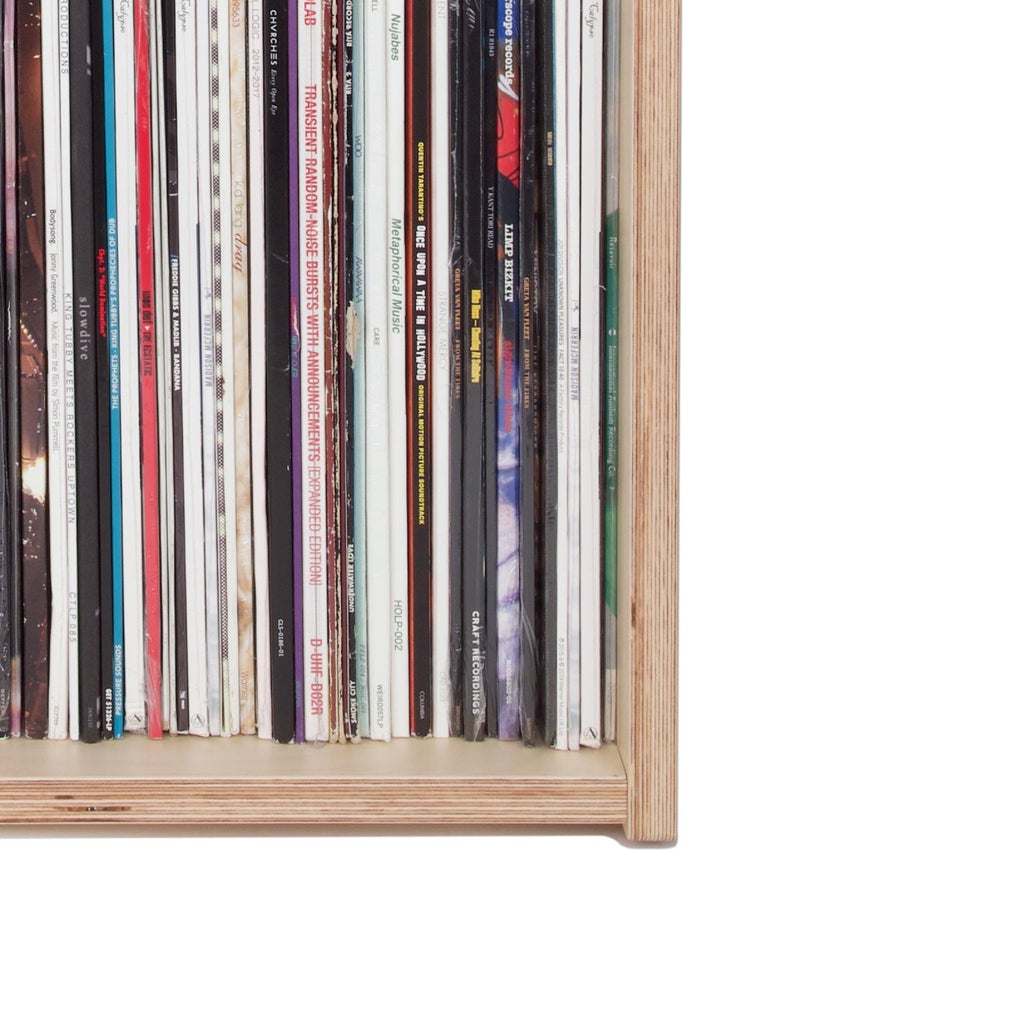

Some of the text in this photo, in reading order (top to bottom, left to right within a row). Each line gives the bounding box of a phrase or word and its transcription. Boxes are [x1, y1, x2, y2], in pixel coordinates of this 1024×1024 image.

[389, 13, 401, 61] Nujabes
[270, 69, 278, 84] Every
[503, 38, 516, 84] records
[269, 88, 277, 103] Open
[270, 104, 278, 116] Eye
[304, 84, 317, 154] TRANSIENT
[108, 218, 116, 234] DUB
[306, 158, 318, 257] RANDOM-NOISE
[109, 236, 116, 247] OF
[415, 225, 426, 248] ONCE
[48, 209, 58, 314] Bodysong. Jonny Greenwood.
[109, 248, 117, 295] PROPHECIES
[171, 258, 180, 287] FREDDIE
[389, 218, 403, 334] Metaphorical Music
[416, 252, 426, 276] UPON
[504, 223, 514, 302] LIMP BIZKIT
[172, 288, 180, 310] GIBBS
[306, 261, 318, 310] BURSTS
[416, 290, 426, 311] TIME
[79, 296, 90, 360] slowdive
[110, 331, 118, 348] KING
[172, 319, 181, 347] MADLIB
[306, 314, 319, 347] WITH
[416, 315, 426, 325] IN
[438, 290, 448, 371] STRANGE MERCY
[110, 354, 118, 393] PROPHETS
[173, 353, 181, 391] BANDANA
[416, 329, 426, 381] HOLLYWOOD
[111, 394, 119, 410] THE
[307, 351, 320, 462] ANNOUNCEMENTS
[502, 340, 513, 433] significant other
[65, 292, 77, 643] KING TUBBY MEETS ROCKERS UPTOWN CTLP 085
[417, 478, 425, 525] SOUNDTRACK
[393, 599, 403, 651] HOLP-002
[114, 644, 122, 716] PRESSURE SOUNDS
[471, 611, 480, 715] CRAFT RECORDINGS
